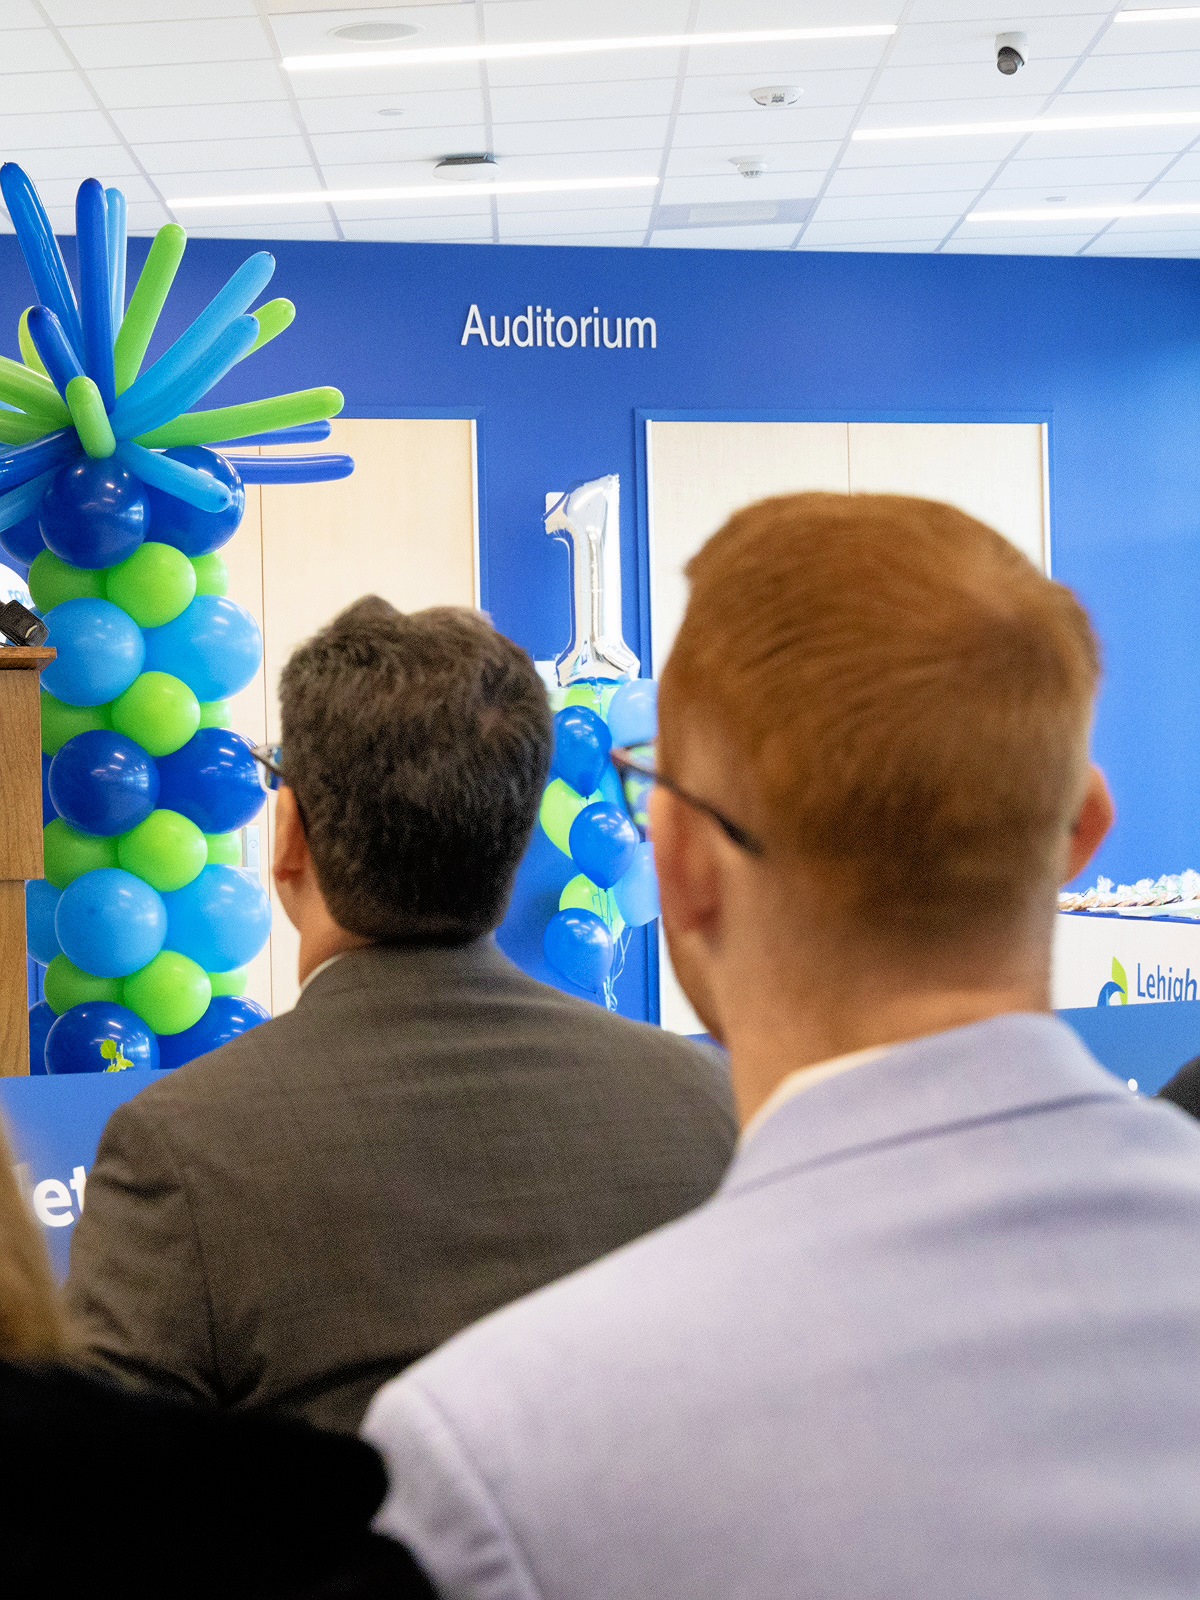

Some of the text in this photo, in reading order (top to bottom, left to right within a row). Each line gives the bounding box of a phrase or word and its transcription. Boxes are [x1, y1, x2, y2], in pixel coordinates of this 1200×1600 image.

[460, 303, 657, 349] Auditorium
[541, 472, 641, 688] 1
[1137, 962, 1198, 1002] Lehigh
[20, 1165, 88, 1228] et
